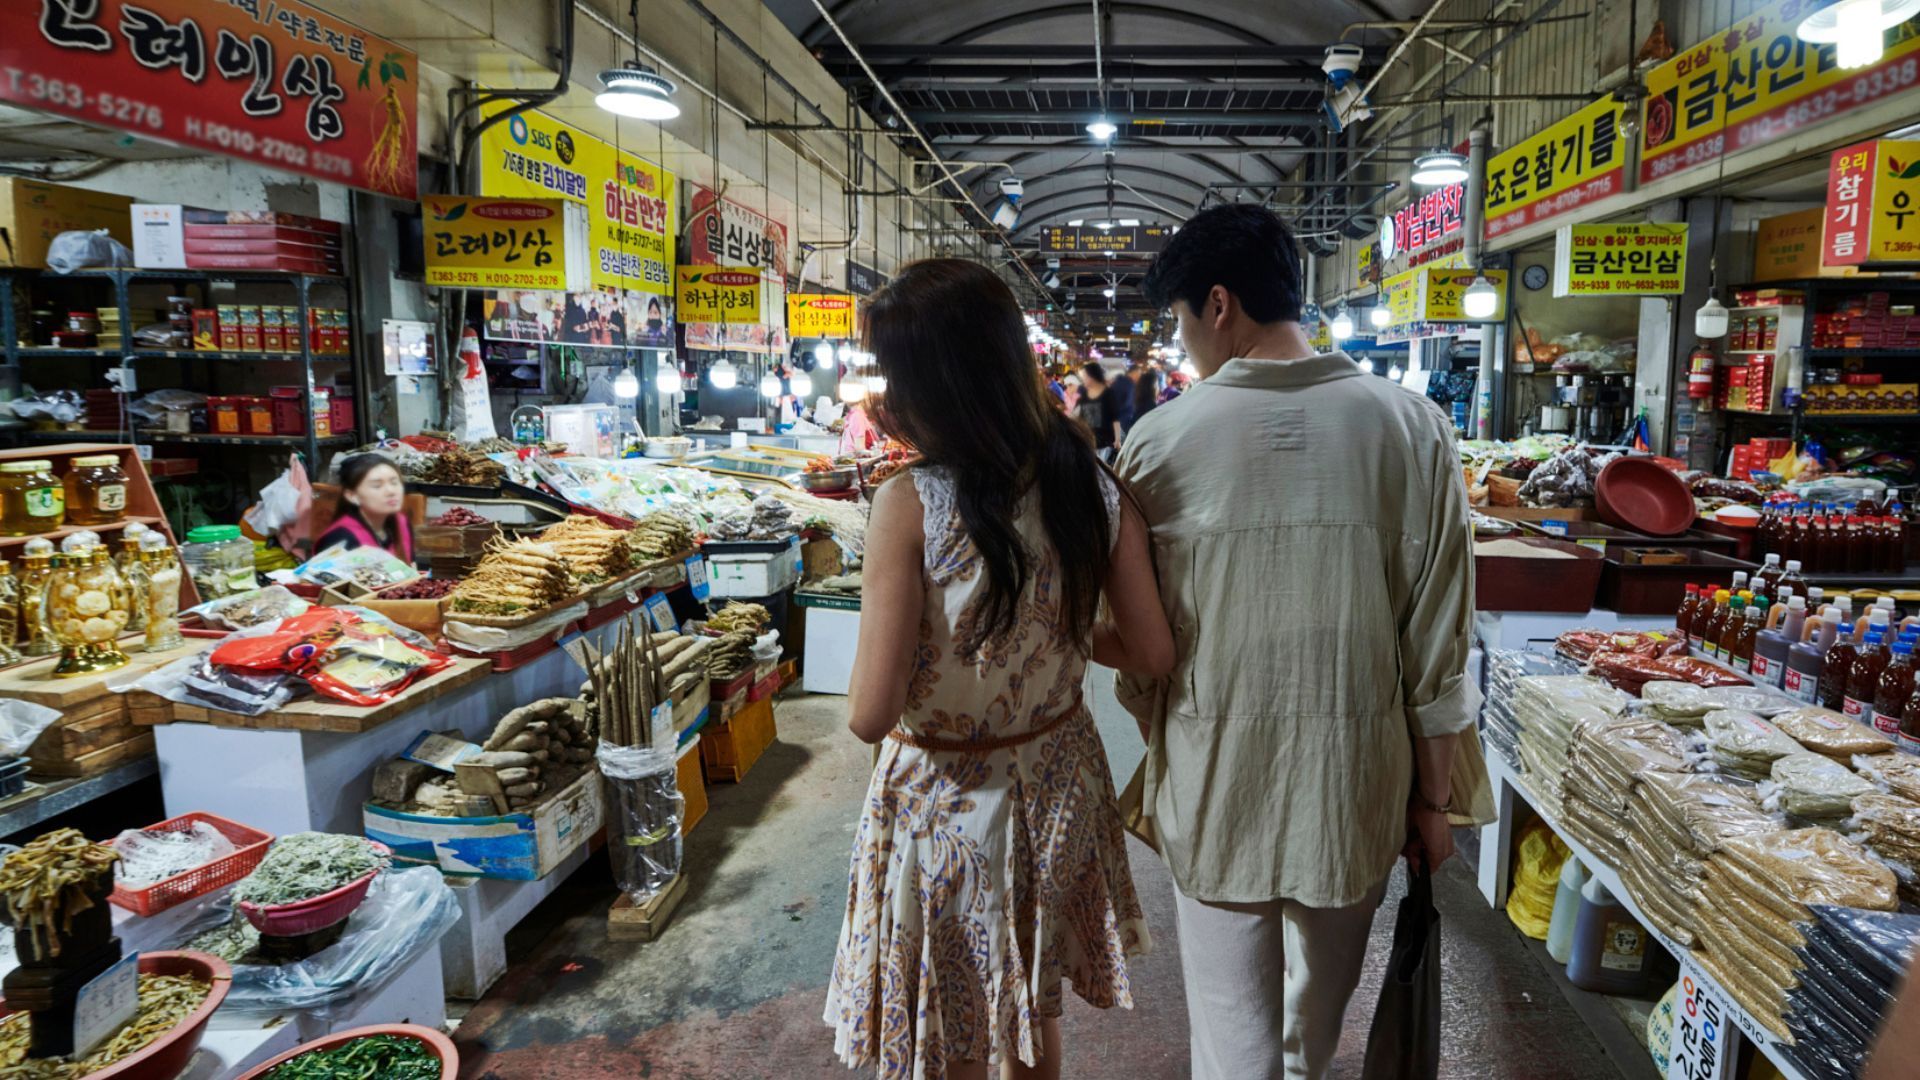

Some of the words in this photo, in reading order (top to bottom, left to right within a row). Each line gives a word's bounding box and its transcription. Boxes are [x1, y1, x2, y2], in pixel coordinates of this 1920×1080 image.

[531, 128, 552, 150] SBS
[1650, 135, 1725, 178] 365-9338
[1488, 108, 1618, 208] 조은참기름
[1836, 151, 1868, 176] 우리
[541, 161, 587, 200] 김치달인
[605, 181, 667, 234] 하남반찬
[1395, 182, 1464, 253] 하남반찬
[1832, 174, 1863, 257] 참기름
[1885, 190, 1920, 231] 우
[434, 228, 553, 267] 고려인삼
[706, 214, 775, 269] 일심상회
[432, 271, 479, 283] T.363-5276
[599, 248, 640, 279] 양심반찬
[1572, 250, 1682, 274] 금산인삼
[684, 288, 755, 310] 하남상회
[1431, 290, 1466, 307] 조은
[1571, 280, 1610, 290] 365-9338
[1738, 1011, 1765, 1045] 1910
